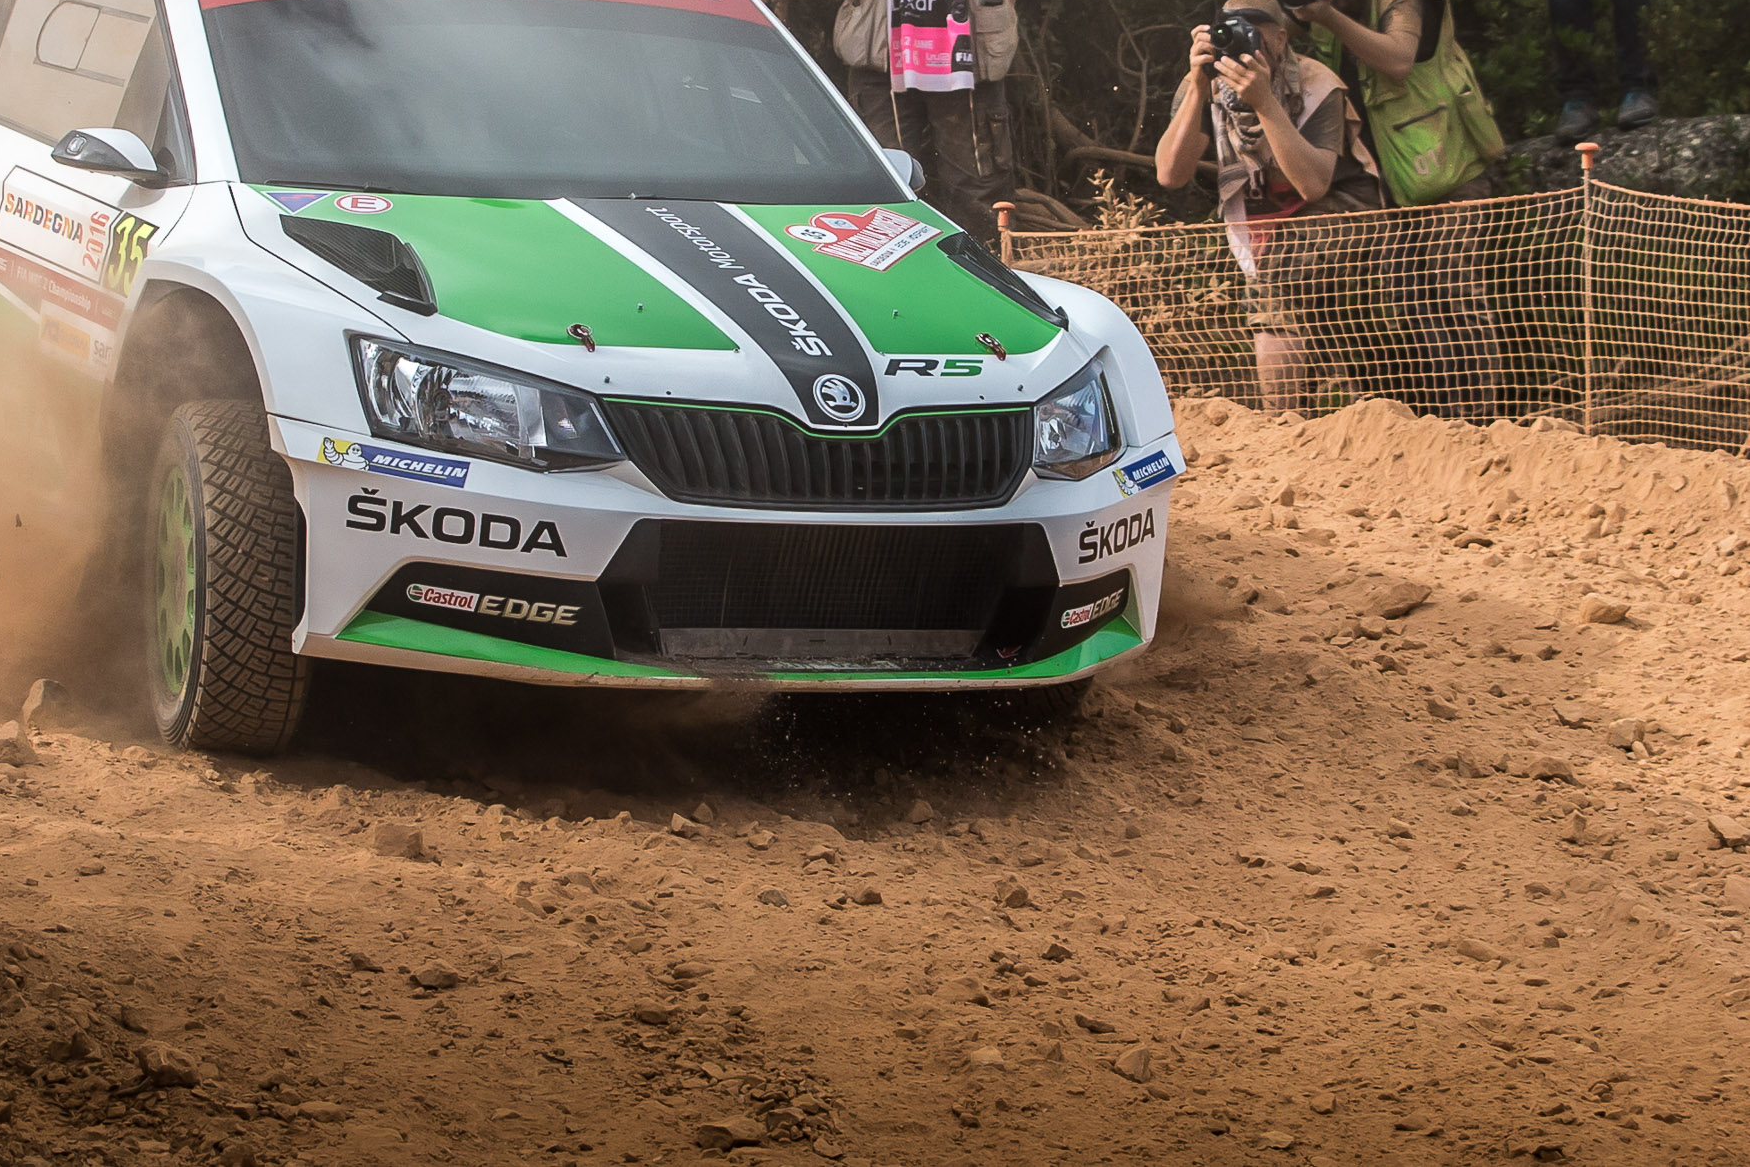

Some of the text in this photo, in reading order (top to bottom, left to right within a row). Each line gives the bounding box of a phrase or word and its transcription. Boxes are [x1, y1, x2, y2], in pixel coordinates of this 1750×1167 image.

[4, 192, 111, 272] SARDEGNA 2016
[108, 216, 155, 294] 35
[645, 206, 744, 271] Motorsport
[733, 273, 833, 358] ŠKODA
[884, 359, 983, 377] R5
[372, 453, 468, 479] MICHELIN
[1132, 455, 1170, 481] MICHELIN
[345, 487, 568, 558] ŠKODA
[1078, 507, 1155, 565] ŠKODA
[422, 587, 583, 625] Castrol EDGE
[1069, 587, 1124, 626] Castrol EDGE
